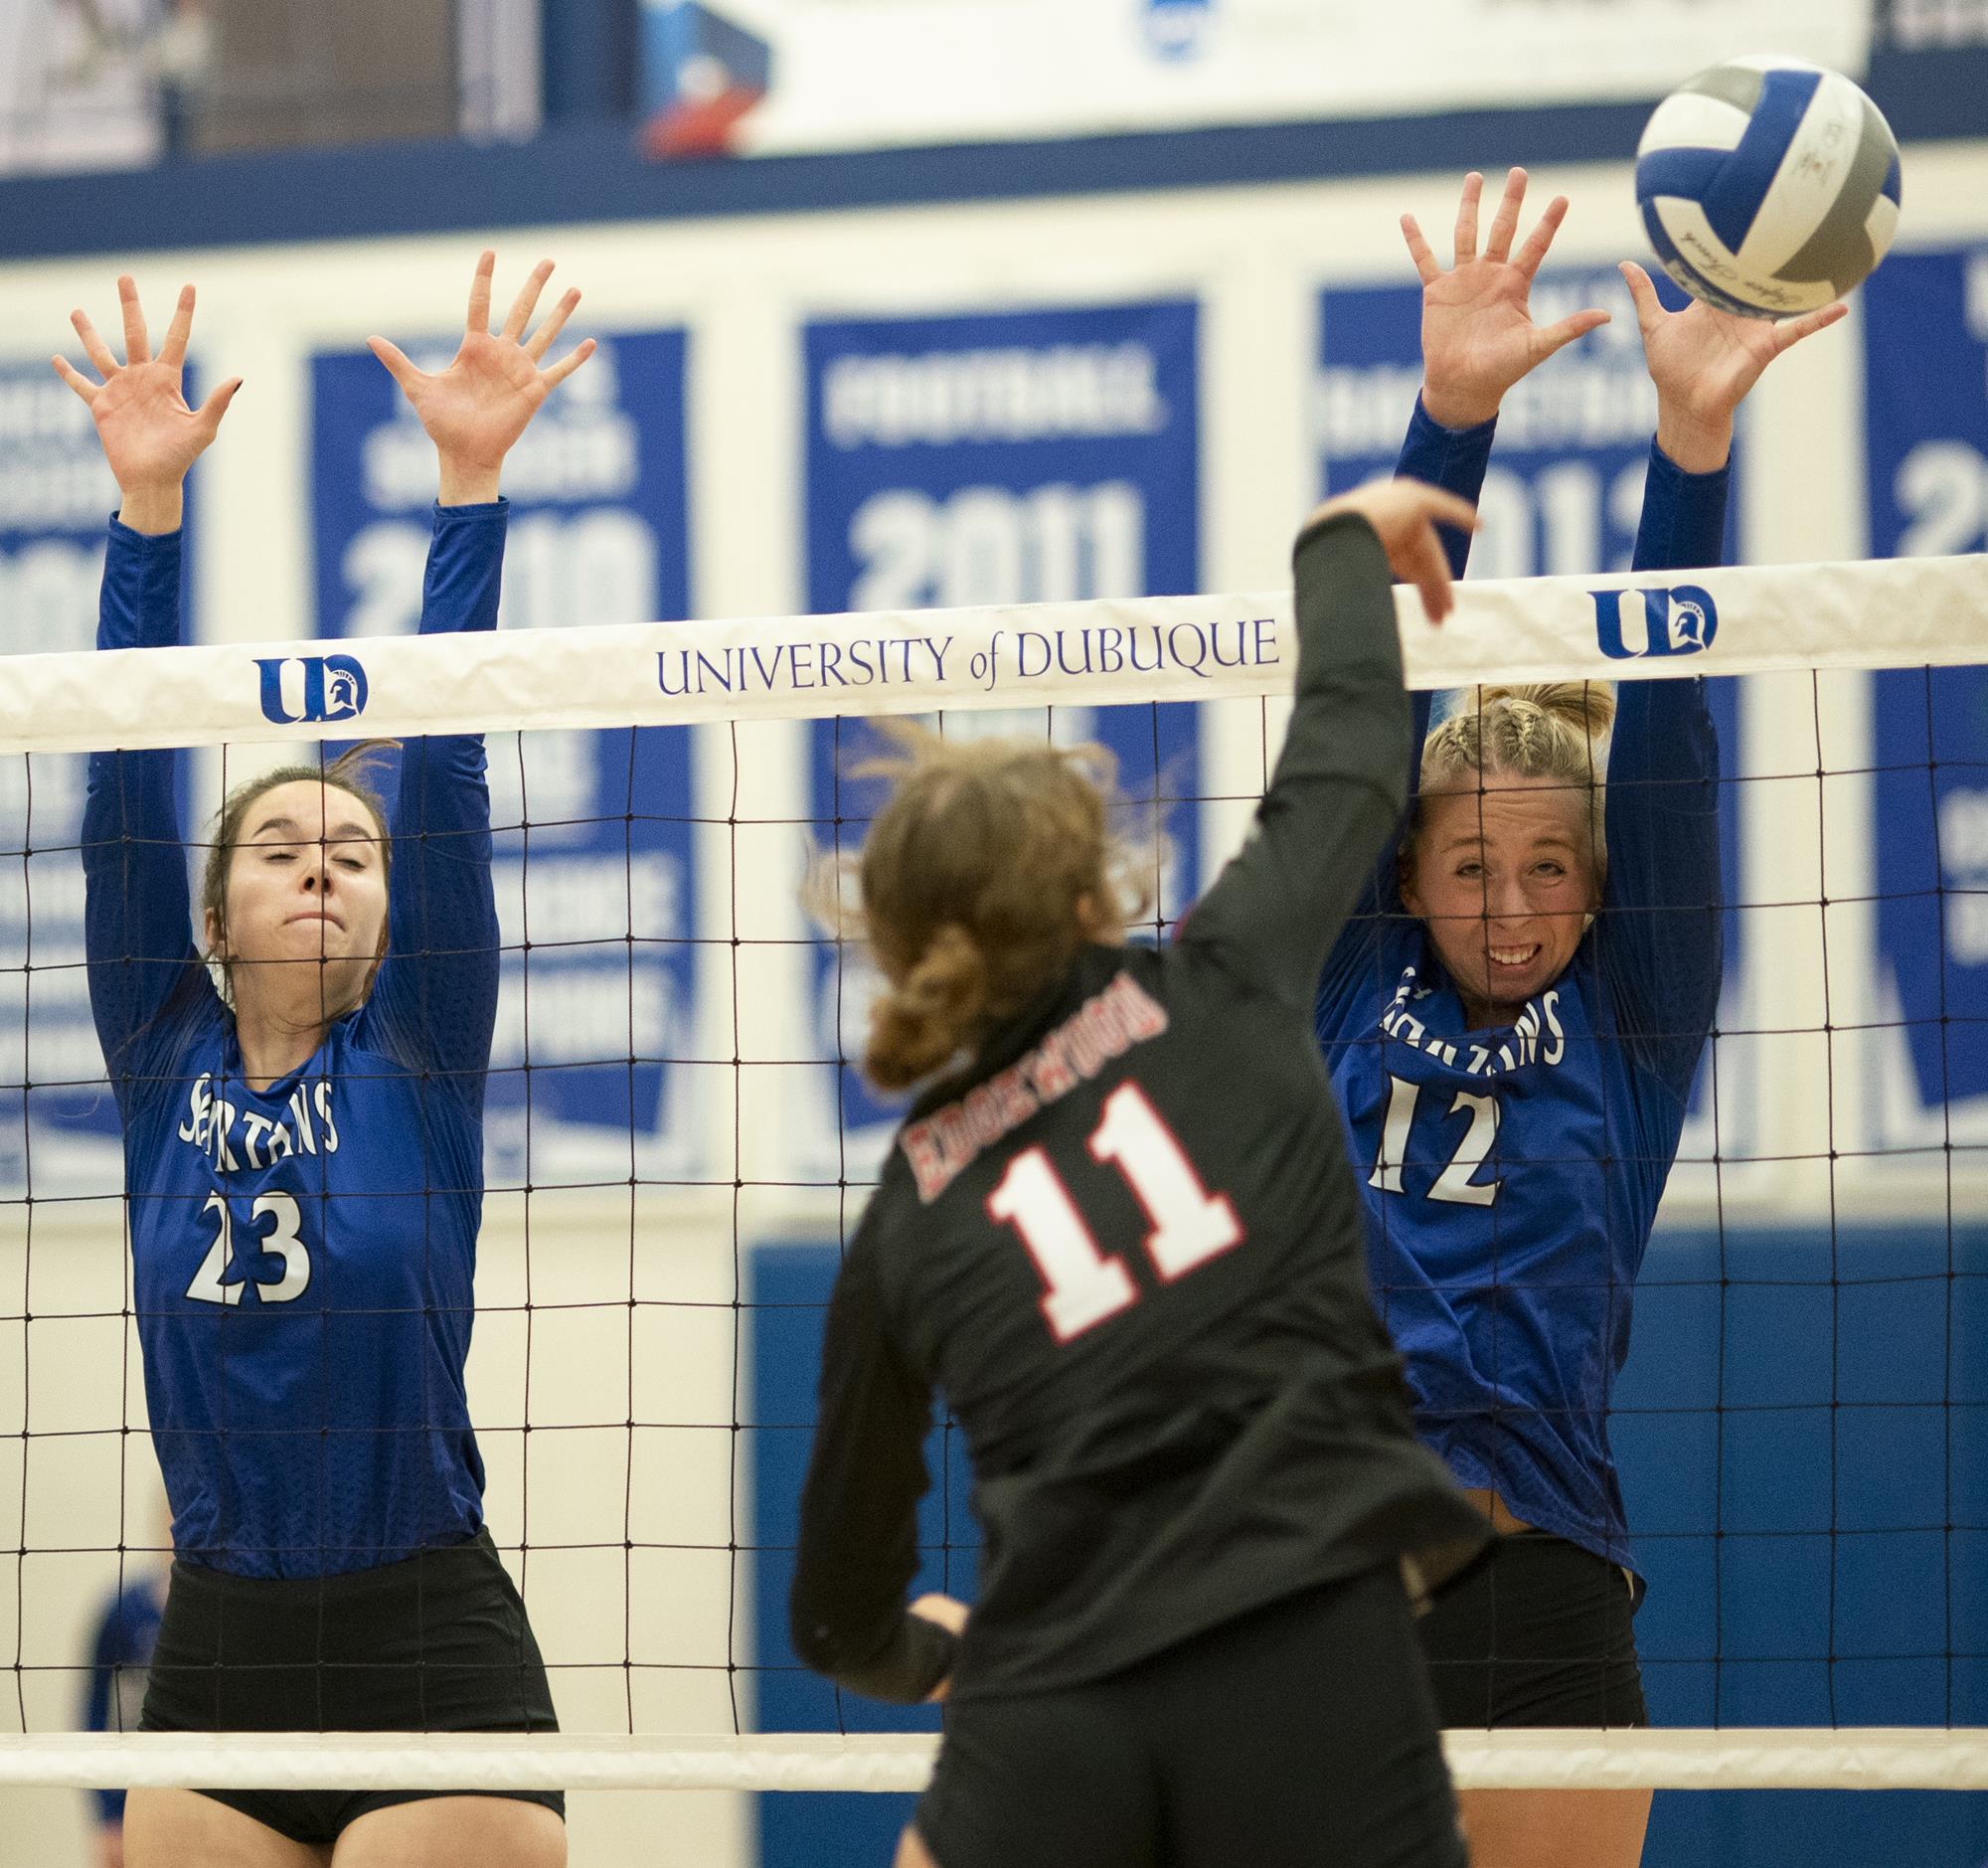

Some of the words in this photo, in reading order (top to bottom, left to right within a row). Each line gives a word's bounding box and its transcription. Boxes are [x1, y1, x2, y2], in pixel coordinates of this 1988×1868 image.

[656, 635, 954, 696] UNIVERSITY
[970, 630, 1004, 692] of
[1016, 618, 1281, 679] DUBUQUE
[1368, 1076, 1501, 1206] 12
[186, 1190, 310, 1305] 23
[983, 1077, 1246, 1344] 11
